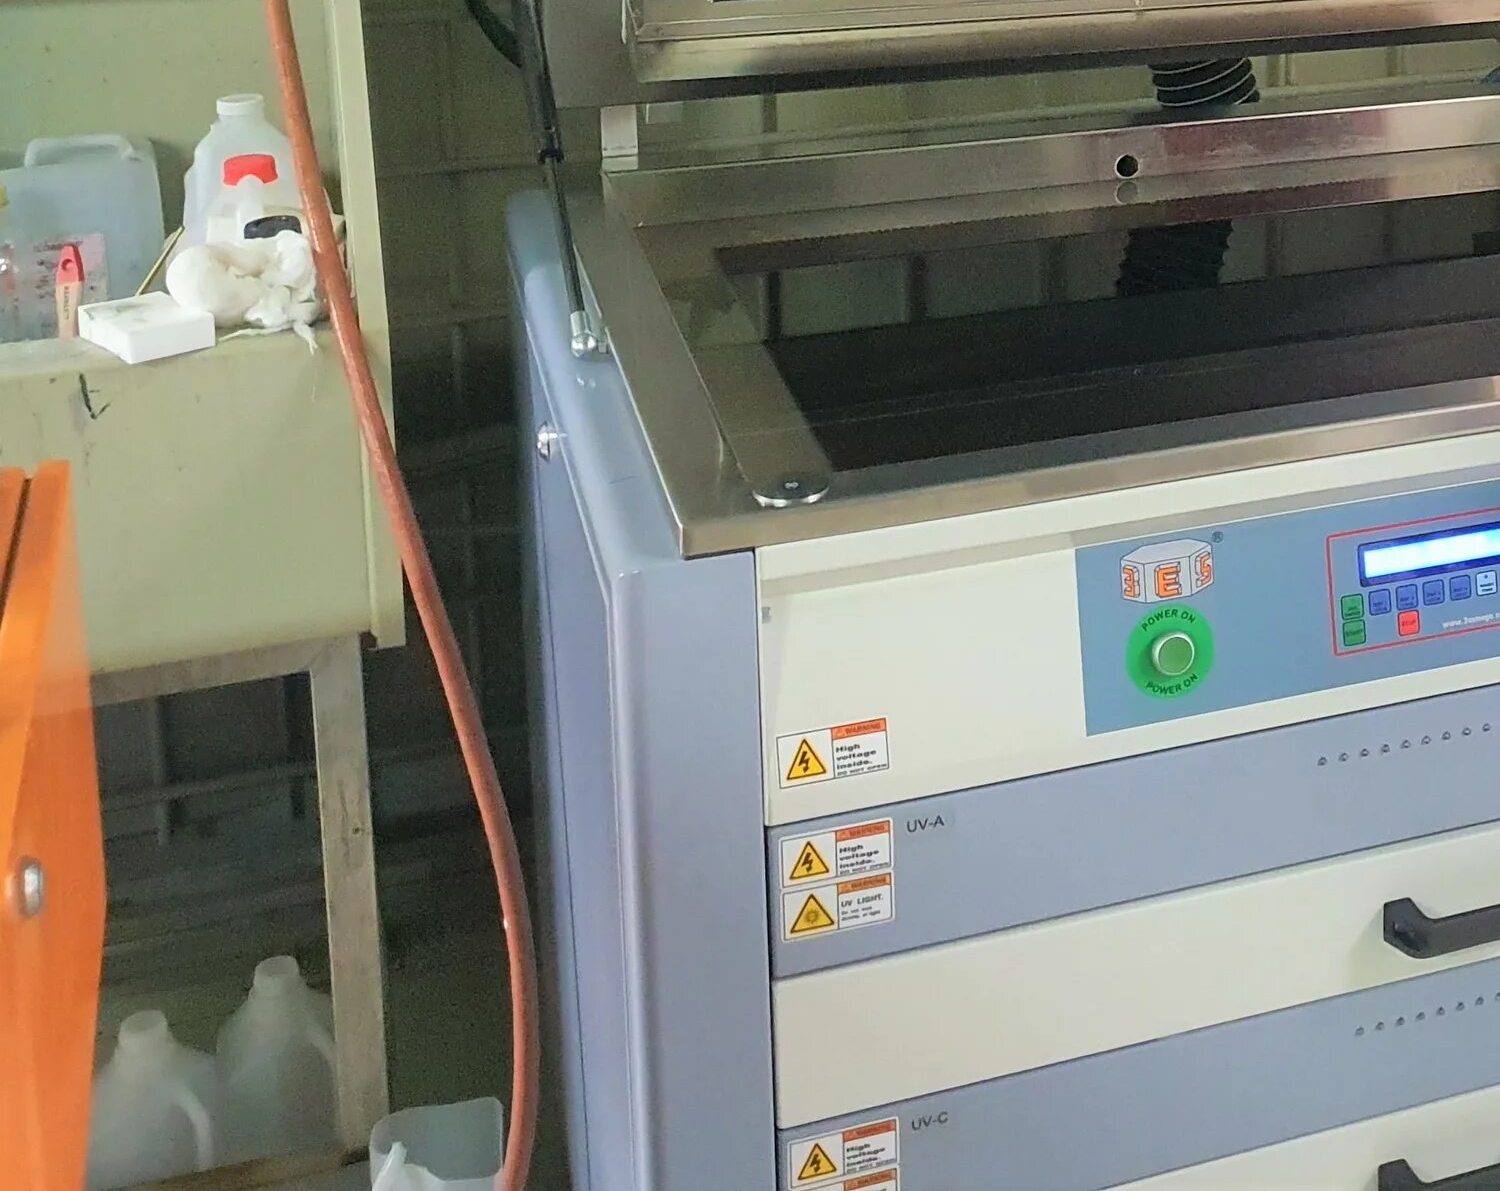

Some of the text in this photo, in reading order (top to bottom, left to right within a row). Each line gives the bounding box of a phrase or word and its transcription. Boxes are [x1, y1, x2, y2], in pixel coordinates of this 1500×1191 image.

[1141, 608, 1196, 632] POWER ON
[1146, 673, 1198, 695] POWER ON
[835, 743, 860, 753] High
[836, 750, 877, 761] voltage
[837, 760, 872, 770] inside.
[906, 815, 945, 833] UV-A
[839, 844, 864, 854] High
[839, 850, 879, 861] voltage
[841, 899, 853, 908] UV
[911, 1111, 949, 1130] UV-C
